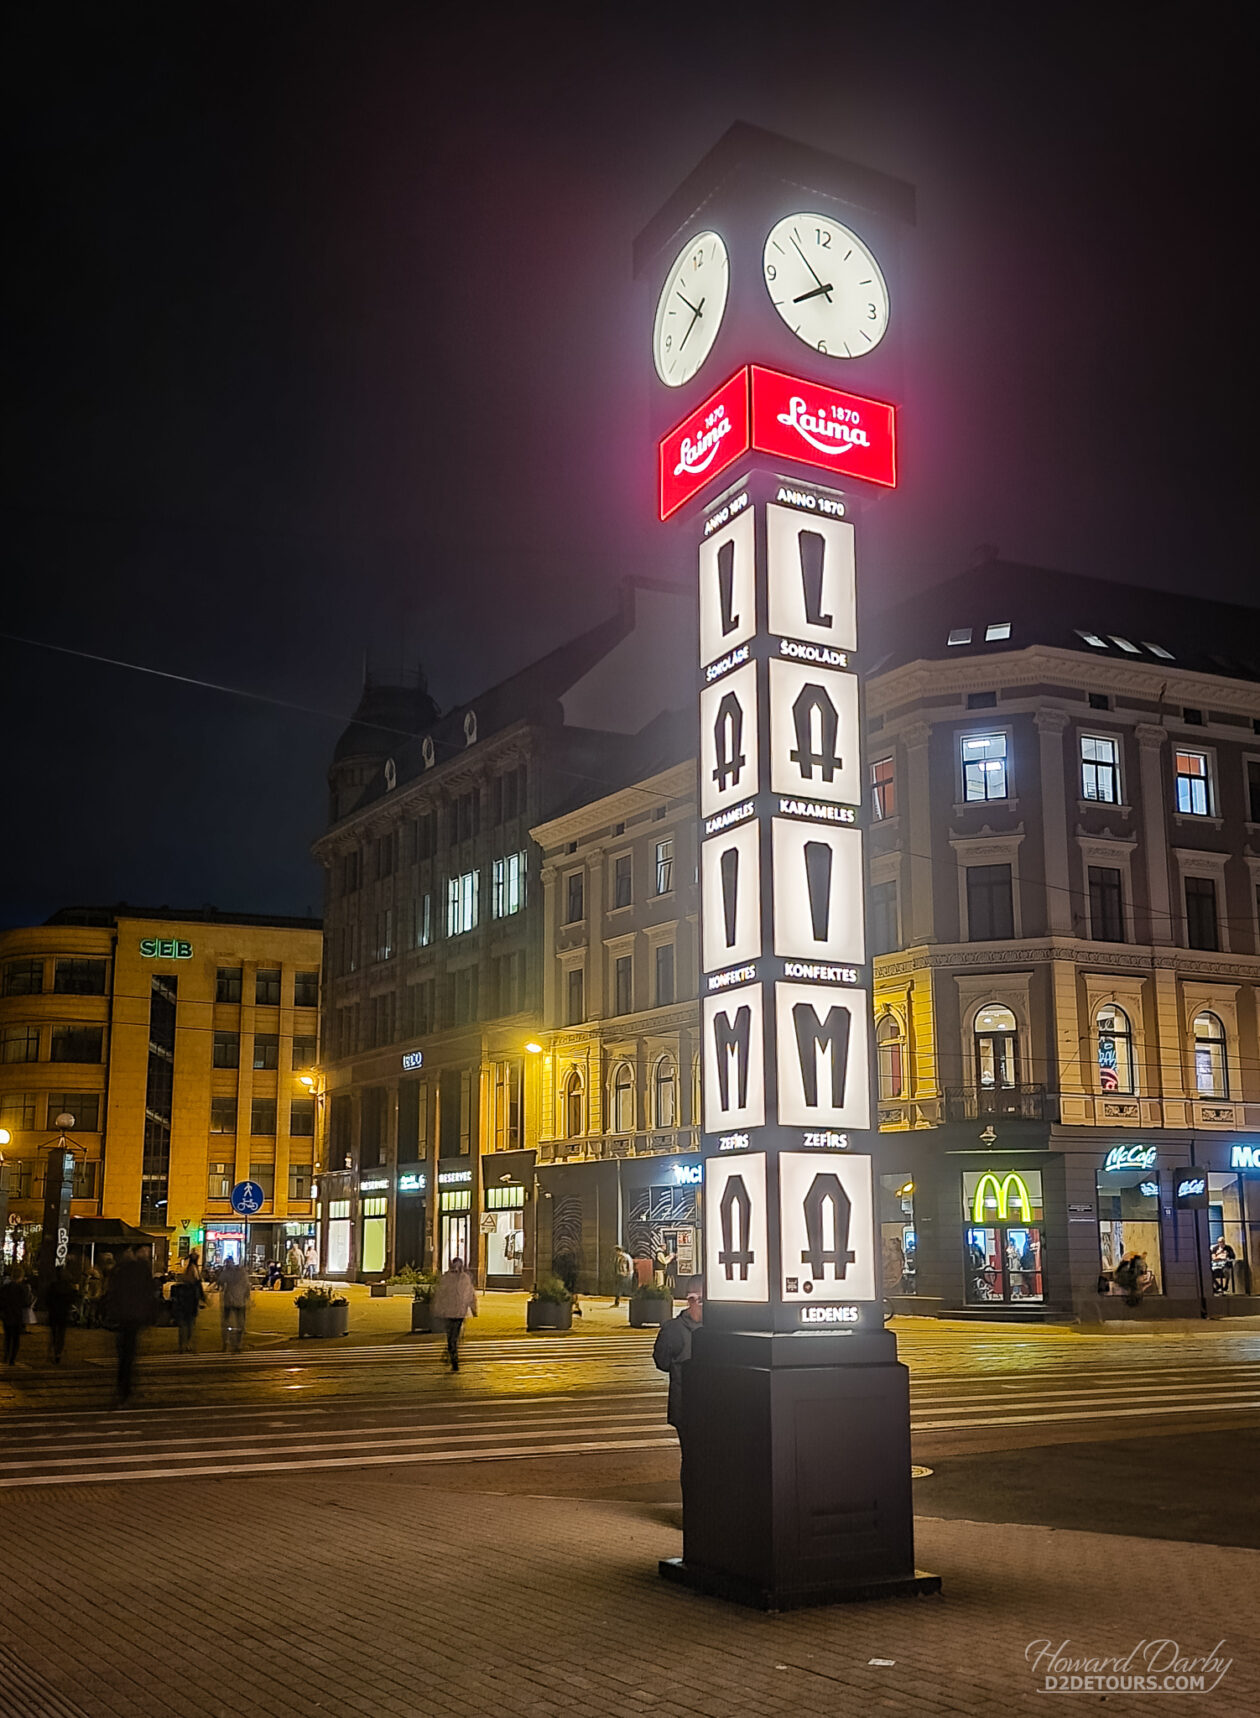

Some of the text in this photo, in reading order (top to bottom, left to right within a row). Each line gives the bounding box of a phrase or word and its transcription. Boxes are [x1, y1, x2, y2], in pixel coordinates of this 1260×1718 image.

[815, 228, 831, 249] 12
[767, 265, 777, 281] 9
[868, 304, 877, 320] 3
[704, 404, 725, 428] 1870
[777, 397, 870, 454] Laima
[831, 405, 860, 425] 1870
[673, 414, 732, 476] Laima
[777, 487, 845, 516] ANNO 1870
[704, 492, 748, 536] ANNO 1870
[706, 801, 754, 835] KARAMELES
[779, 799, 855, 823] KARAMELES
[140, 938, 193, 960] SEB
[709, 965, 756, 990] KONFEKTES
[784, 963, 857, 983] KONFEKTES
[801, 1306, 858, 1322] LEDENES
